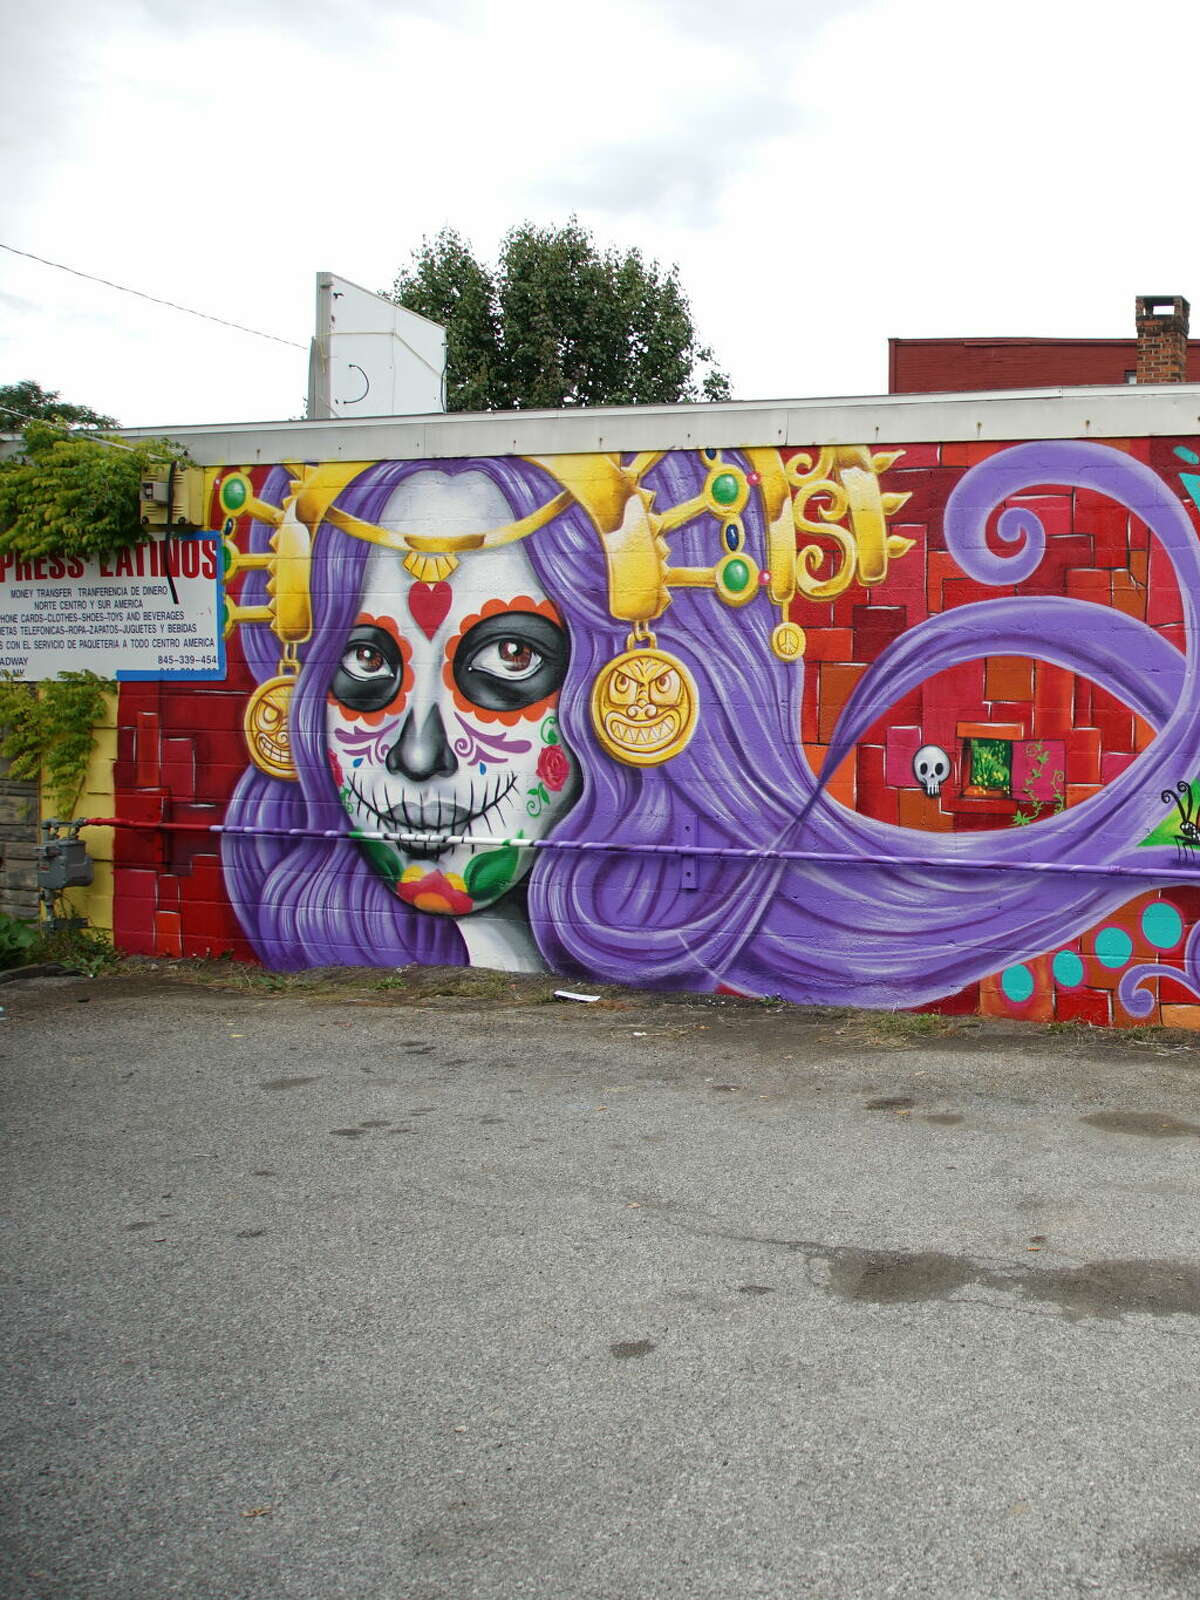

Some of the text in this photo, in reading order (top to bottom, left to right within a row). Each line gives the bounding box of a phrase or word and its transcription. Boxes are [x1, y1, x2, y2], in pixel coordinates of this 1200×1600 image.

[100, 540, 217, 580] LATINOS
[11, 585, 167, 598] MONEY TRANSFER TRANFERENCIA DE DINERO
[34, 599, 143, 610] NORTE CENTRO Y SUR AMERICA
[0, 614, 18, 623] HONE
[127, 612, 140, 621] AND
[143, 611, 184, 621] BEVERAGES
[160, 624, 165, 633] Y
[167, 624, 197, 633] BEBIDAS
[6, 641, 20, 650] CON
[23, 640, 31, 650] EL
[34, 640, 65, 649] SERVICIO
[67, 640, 77, 649] DE
[79, 639, 119, 649] PAQUETERIA
[122, 639, 128, 648] A
[131, 639, 149, 648] TODO
[152, 638, 180, 648] CENTRO
[183, 638, 214, 647] AMERICA
